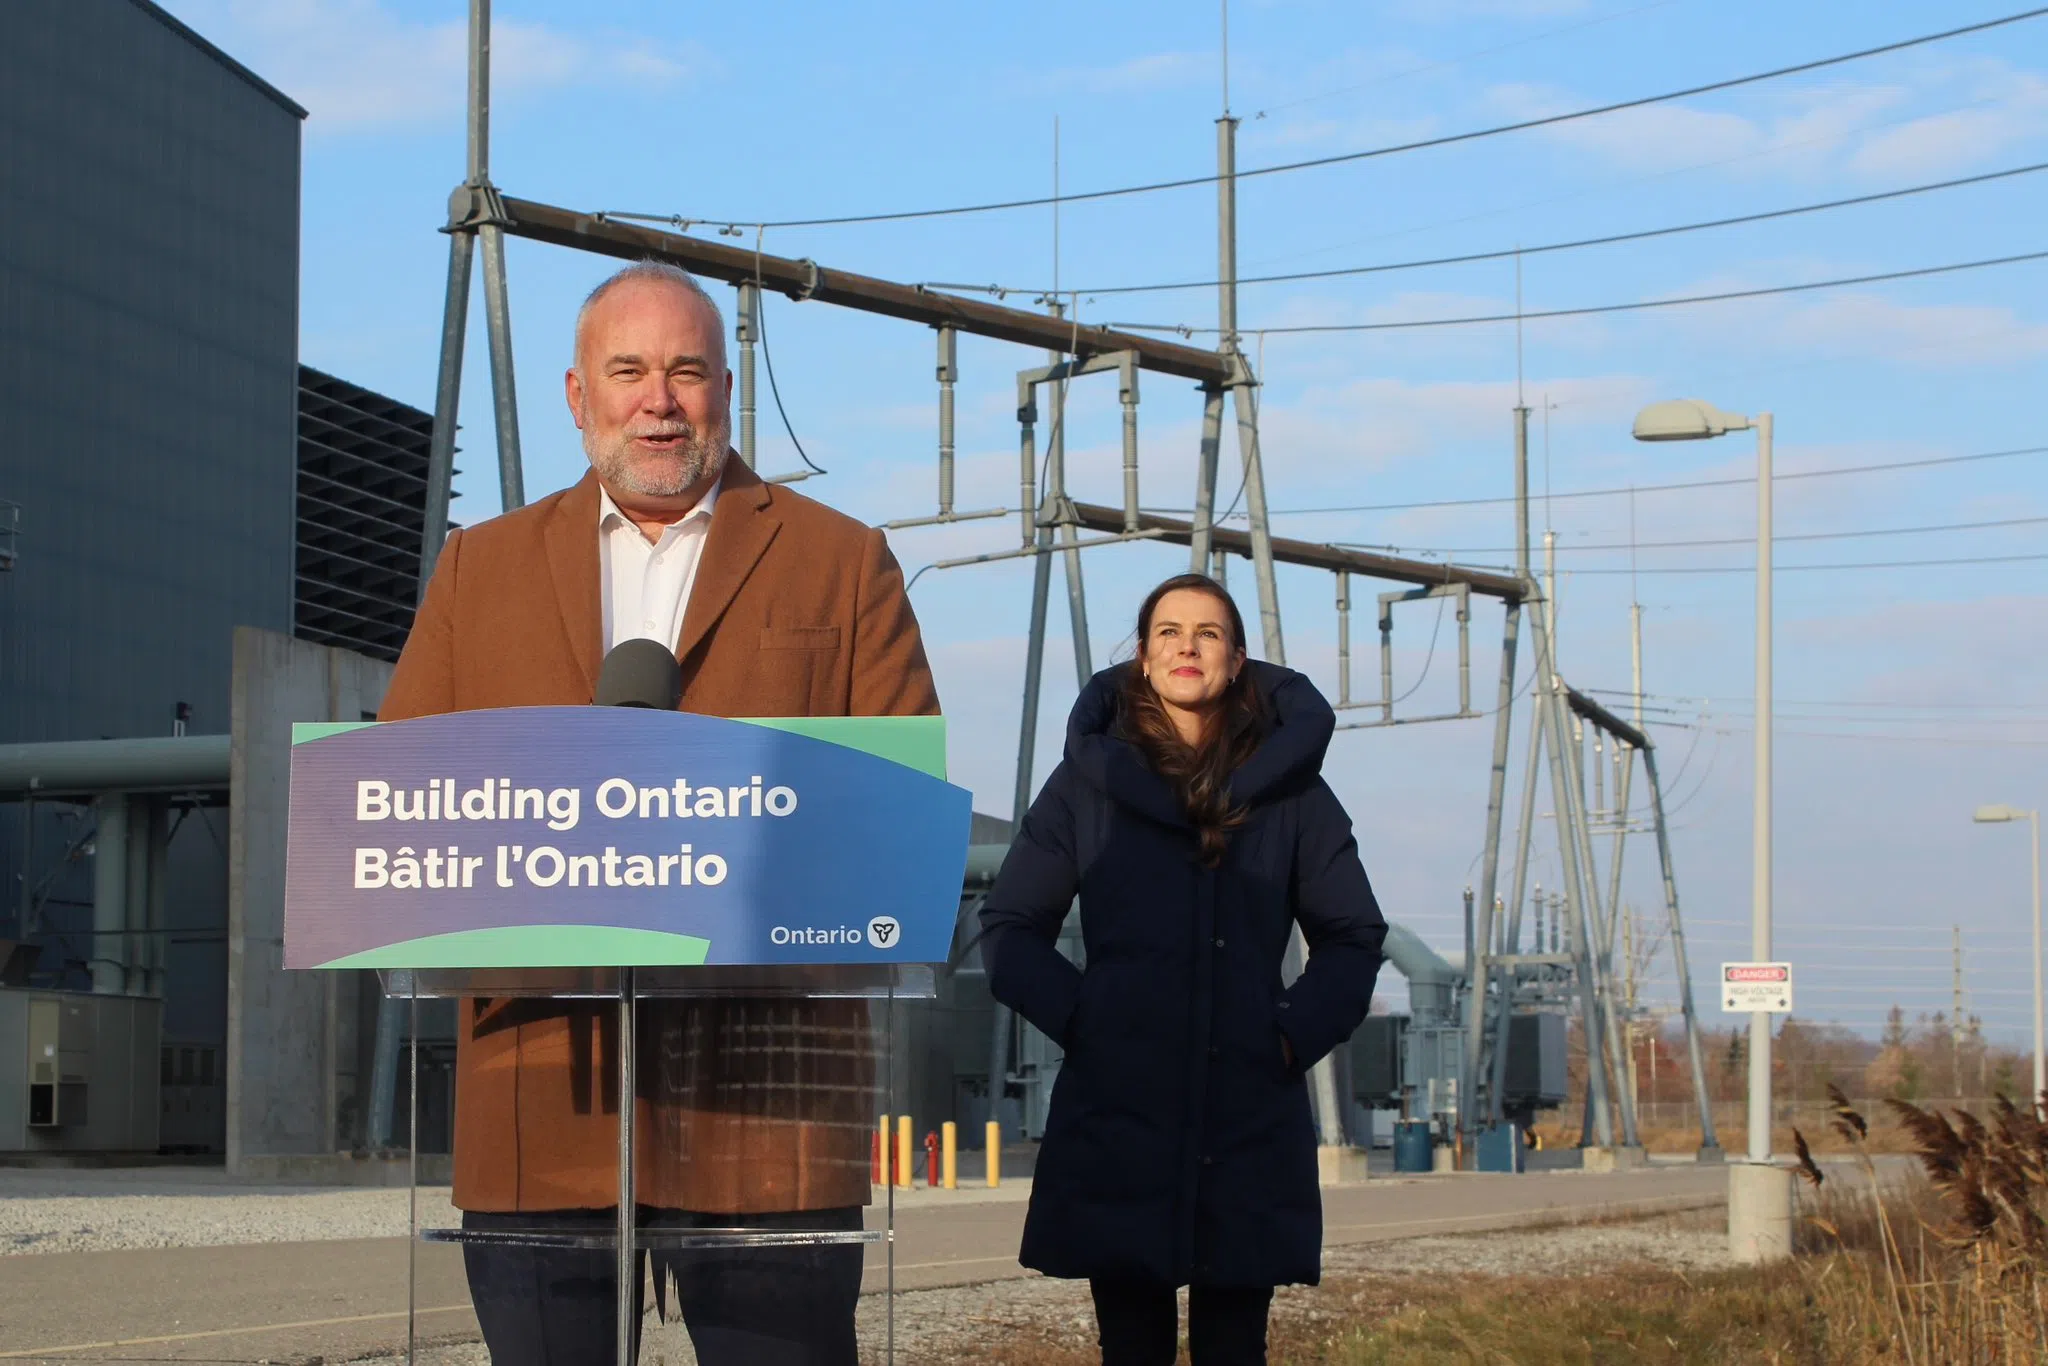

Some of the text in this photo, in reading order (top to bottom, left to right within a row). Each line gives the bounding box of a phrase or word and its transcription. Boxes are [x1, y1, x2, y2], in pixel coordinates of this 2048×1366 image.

[356, 775, 798, 831] Building Ontario
[353, 846, 483, 889] Bâtir
[770, 925, 862, 945] Ontario
[1734, 969, 1779, 979] DANGER
[1730, 986, 1784, 995] HIGH VOLTAGE
